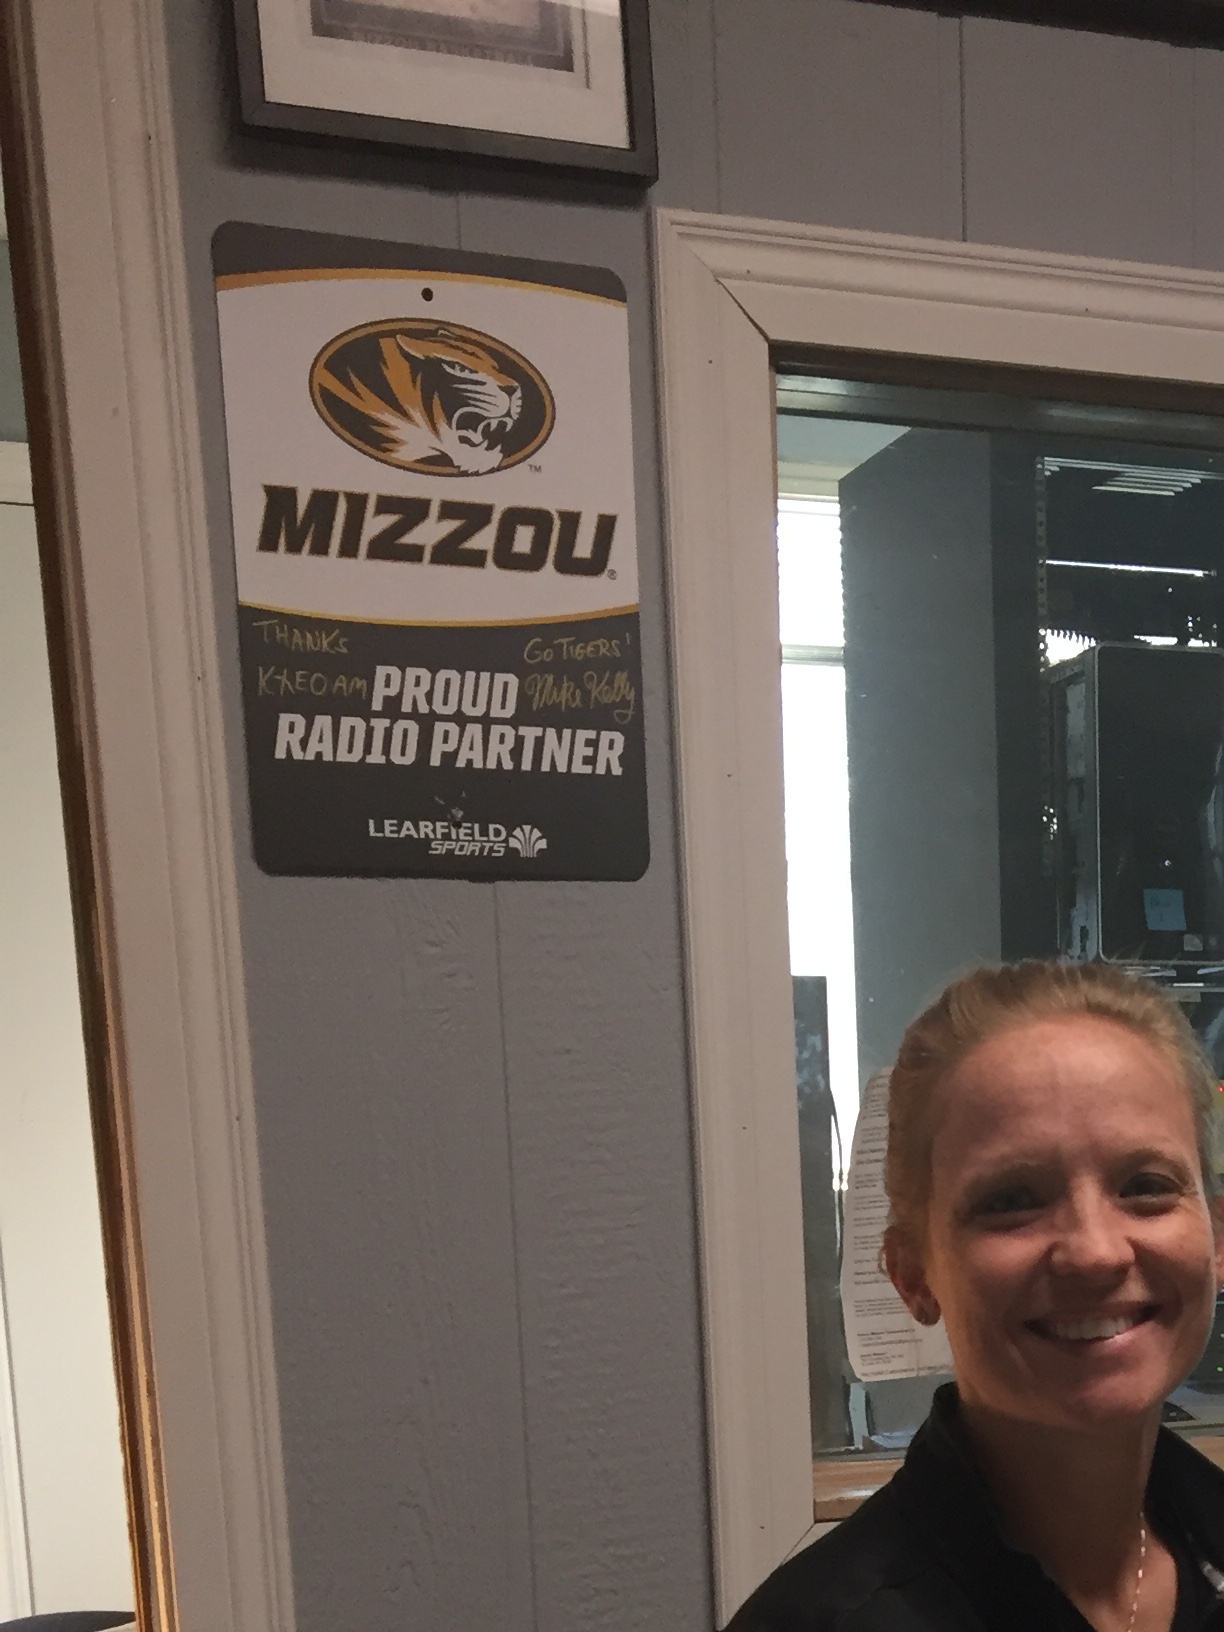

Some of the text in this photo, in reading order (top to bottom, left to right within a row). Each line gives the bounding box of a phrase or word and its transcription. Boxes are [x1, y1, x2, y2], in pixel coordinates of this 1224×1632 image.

[257, 483, 618, 578] MIZZOU
[371, 664, 519, 720] PROUD
[274, 712, 625, 776] RADIO PARTNER
[368, 819, 507, 842] LEARFIELD
[428, 840, 507, 857] SPORTS
